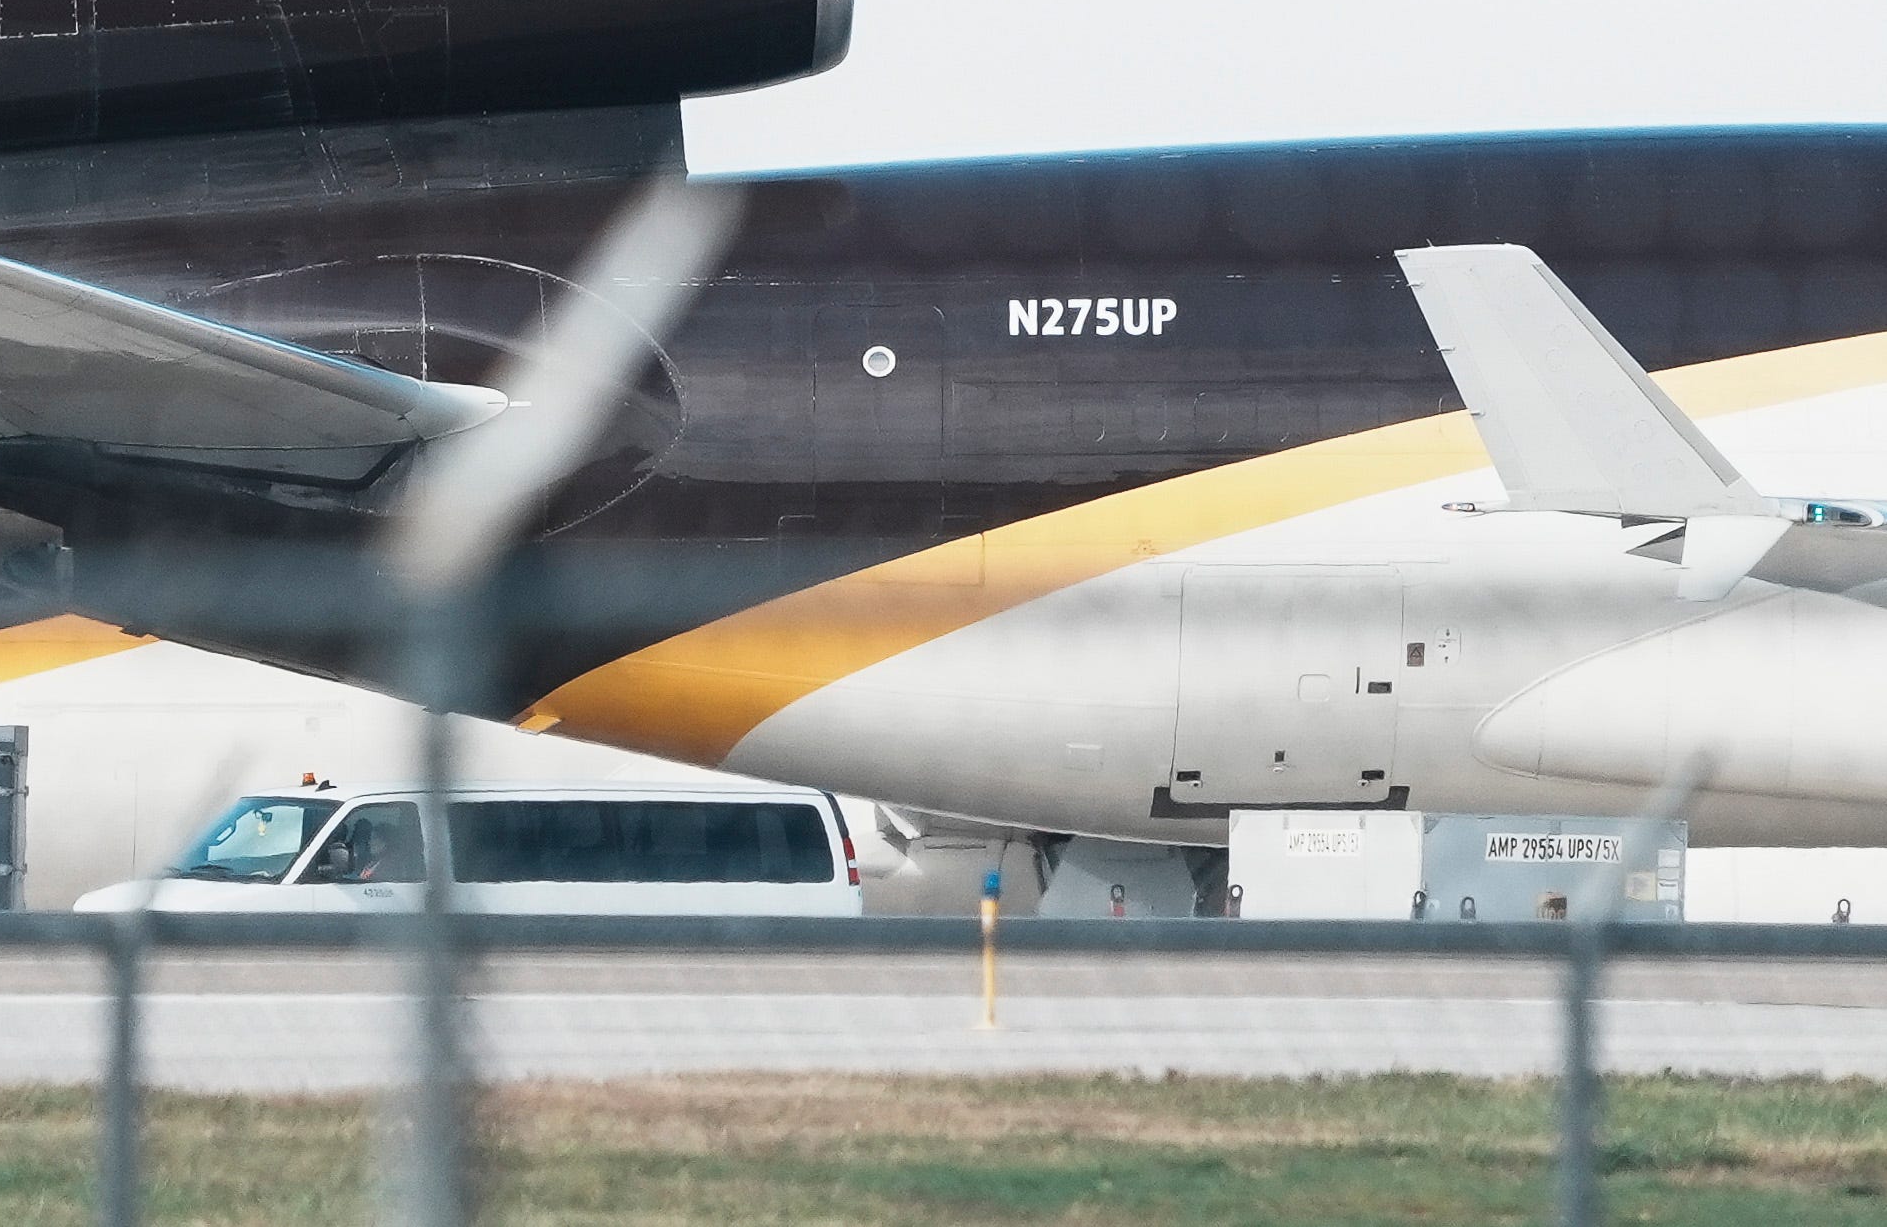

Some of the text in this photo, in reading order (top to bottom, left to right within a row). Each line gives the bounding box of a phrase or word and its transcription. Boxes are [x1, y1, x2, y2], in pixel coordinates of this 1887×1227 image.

[1008, 297, 1177, 336] N275UP
[1488, 836, 1620, 861] AMP 29554 UPS/5X
